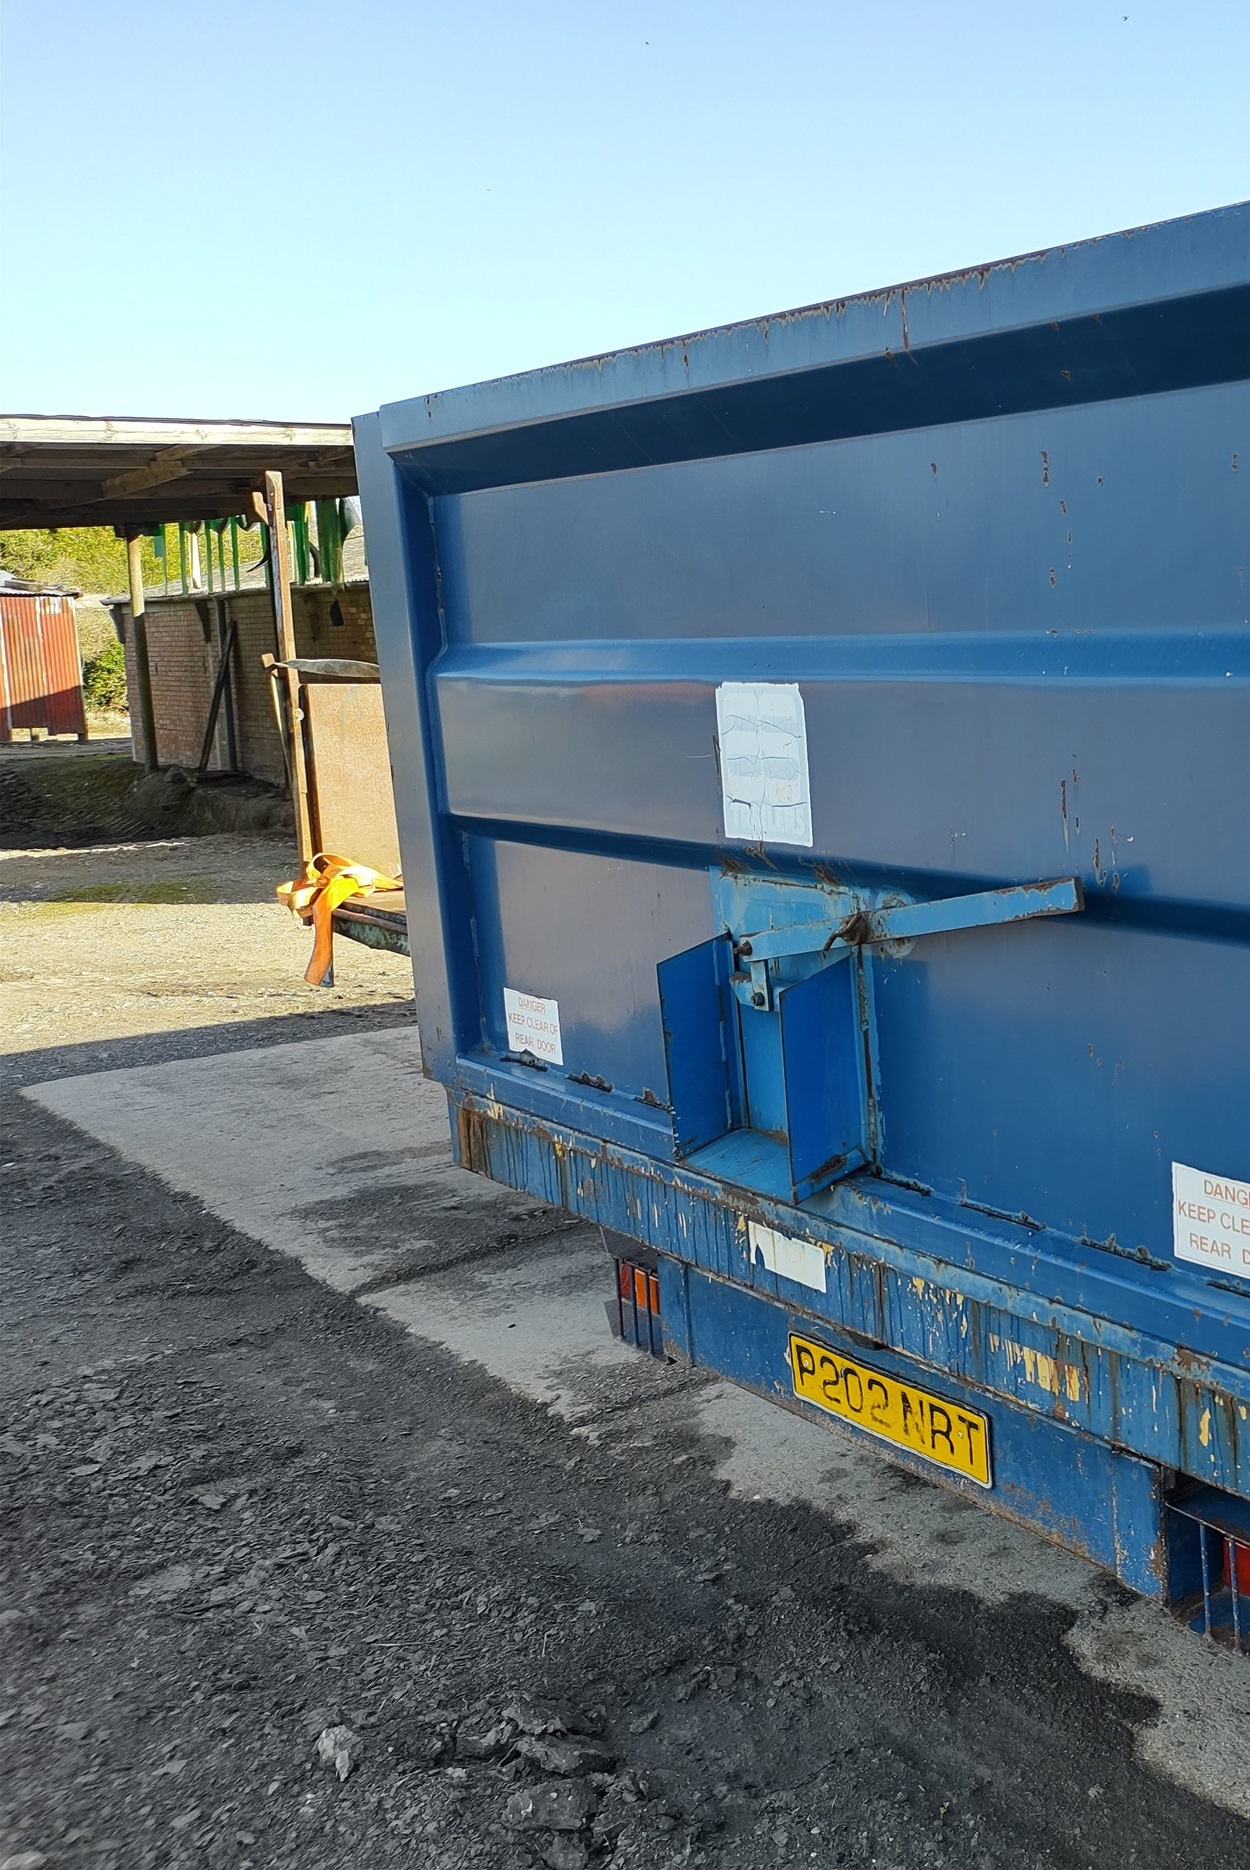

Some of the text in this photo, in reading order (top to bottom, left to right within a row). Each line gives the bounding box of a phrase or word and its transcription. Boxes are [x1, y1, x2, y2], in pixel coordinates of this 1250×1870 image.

[518, 996, 546, 1013] DANGER
[508, 1012, 559, 1036] KEEP CLEAR OF
[515, 1032, 556, 1054] REAR DOOR
[1178, 1200, 1216, 1224] KEEP
[1189, 1232, 1231, 1259] REAR
[795, 1344, 979, 1466] P202 NRT
